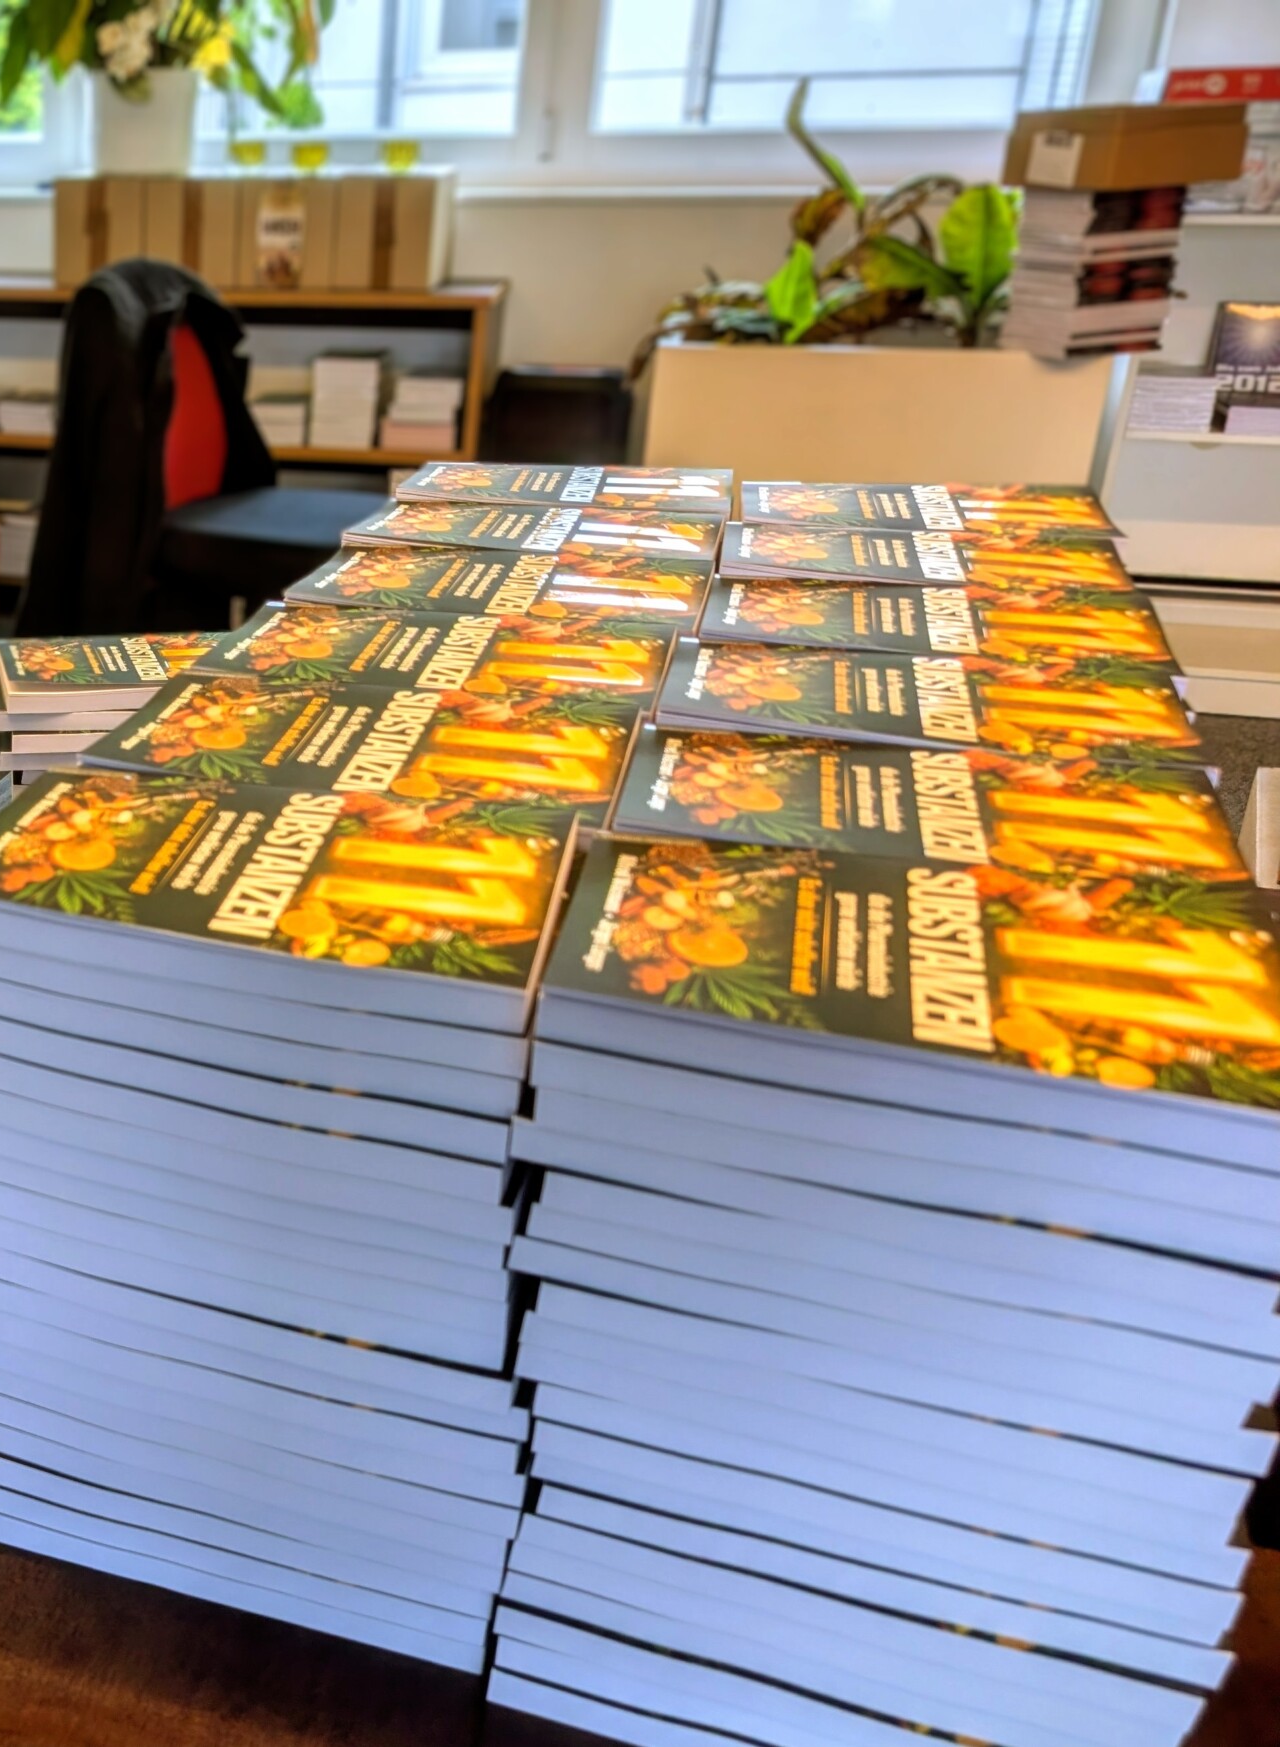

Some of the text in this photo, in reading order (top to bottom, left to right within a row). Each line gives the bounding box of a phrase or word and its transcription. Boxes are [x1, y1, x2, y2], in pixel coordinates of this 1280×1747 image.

[1215, 374, 1280, 391] 2012
[414, 616, 501, 690] SUBSTANZEN
[911, 657, 979, 743] SUBSTANZEN
[331, 690, 443, 793] SUBSTANZEN
[909, 750, 991, 865] SUBSTANZEN
[207, 792, 346, 939] SUBSTANZEN
[311, 836, 540, 927] 77
[906, 867, 996, 1053] SUBSTANZEN
